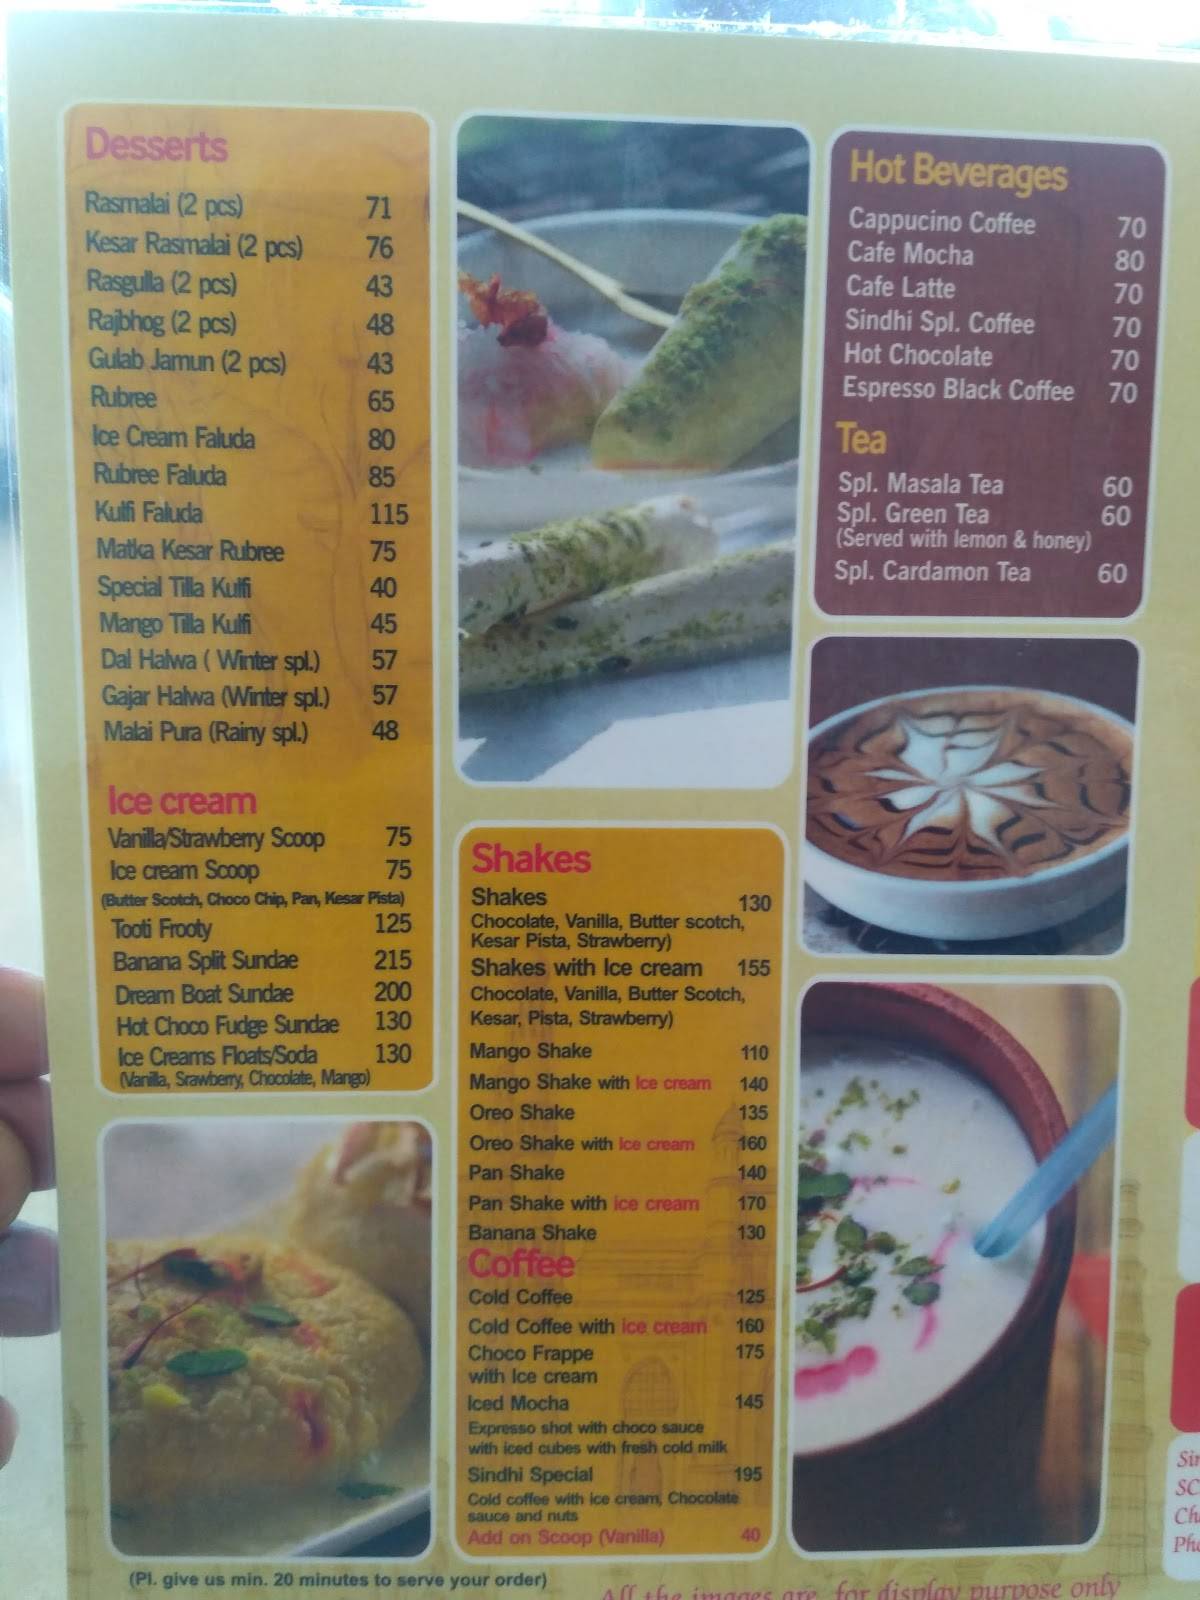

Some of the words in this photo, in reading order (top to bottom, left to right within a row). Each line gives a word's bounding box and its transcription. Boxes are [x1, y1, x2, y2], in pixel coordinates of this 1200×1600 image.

[86, 127, 228, 163] Desserts
[850, 150, 905, 184] Hot
[914, 152, 1068, 198] Beverages
[85, 191, 169, 213] Rasmalai
[178, 193, 197, 217] (2
[206, 194, 243, 220] pcs)
[367, 196, 391, 219] 71
[850, 207, 961, 235] Cappucino
[969, 212, 1036, 234] Coffee
[1118, 217, 1146, 238] 70
[848, 241, 895, 263] Cafe
[904, 242, 974, 265] Mocha
[1114, 250, 1144, 271] 80
[847, 275, 894, 296] Cafe
[902, 277, 956, 299] Latte
[1114, 284, 1143, 304] 70
[846, 308, 912, 331] Sindhi
[920, 311, 960, 336] Spl.
[968, 312, 1035, 334] Coffee
[1112, 317, 1141, 338] 70
[844, 343, 881, 364] Hot
[889, 343, 992, 366] Chocolate
[1110, 350, 1139, 370] 70
[91, 386, 157, 408] Rubree
[368, 391, 395, 412] 65
[843, 376, 935, 401] Espresso
[944, 377, 1001, 399] Black
[1009, 379, 1074, 401] Coffee
[1109, 383, 1137, 403] 70
[93, 425, 118, 447] Ice
[127, 425, 187, 447] Cream
[196, 427, 255, 449] Faluda
[368, 429, 395, 450] 80
[836, 421, 887, 454] Tea
[94, 462, 159, 484] Rubree
[167, 464, 226, 486] Faluda
[368, 466, 395, 487] 85
[839, 471, 877, 496] Spl.
[888, 473, 960, 493] Masala
[969, 474, 1004, 494] Tea
[1103, 476, 1132, 497] 60
[837, 502, 876, 527] Spl.
[886, 503, 946, 523] Green
[956, 503, 989, 524] Tea
[1101, 506, 1131, 525] 60
[97, 538, 153, 559] Matka
[162, 539, 212, 561] Kesar
[221, 540, 284, 561] Rubree
[370, 541, 396, 562] 75
[837, 528, 903, 548] (Served
[910, 529, 947, 547] with
[954, 530, 1007, 549] lemon
[1014, 532, 1026, 549] &
[1033, 531, 1092, 554] honey)
[835, 560, 873, 584] Spl.
[883, 560, 988, 581] Cardamon
[998, 562, 1031, 582] Tea
[1098, 564, 1127, 583] 60
[109, 785, 152, 815] Ice
[160, 793, 257, 815] cream
[472, 844, 591, 873] Shakes
[111, 860, 136, 880] Ice
[143, 864, 197, 879] cream
[205, 860, 260, 883] Scoop
[386, 860, 411, 879] 75
[472, 888, 547, 906] Shakes
[739, 895, 771, 912] 130
[112, 918, 151, 938] Tooti
[160, 918, 212, 942] Frooty
[375, 914, 411, 933] 125
[471, 914, 559, 931] Chocolate,
[565, 914, 622, 931] Vanilla,
[630, 914, 678, 929] Butter
[686, 914, 744, 931] scotch,
[472, 933, 517, 948] Kesar
[526, 933, 569, 950] Pista,
[577, 933, 671, 950] Strawberry)
[114, 952, 181, 971] Banana
[189, 951, 226, 975] Split
[233, 950, 298, 969] Sundae
[374, 950, 412, 970] 215
[472, 959, 545, 976] Shakes
[554, 959, 594, 976] with
[604, 959, 632, 976] Ice
[641, 963, 702, 976] cream
[738, 960, 770, 976] 155
[116, 985, 174, 1005] Dream
[182, 984, 221, 1004] Boat
[229, 983, 293, 1003] Sundae
[374, 981, 411, 1001] 200
[471, 1043, 530, 1062] Mango
[538, 1043, 592, 1057] Shake
[741, 1046, 768, 1061] 110
[470, 1074, 529, 1094] Mango
[538, 1074, 591, 1089] Shake
[598, 1076, 629, 1089] with
[636, 1076, 657, 1089] Ice
[664, 1079, 711, 1089] cream
[740, 1077, 768, 1091] 140
[470, 1105, 513, 1120] Oreo
[520, 1105, 575, 1120] Shake
[739, 1106, 768, 1120] 135
[470, 1136, 513, 1151] Oreo
[520, 1136, 574, 1150] Shake
[582, 1138, 612, 1150] with
[619, 1138, 640, 1150] Ice
[647, 1140, 694, 1150] cream
[739, 1136, 766, 1150] 160
[469, 1165, 502, 1180] Pan
[510, 1165, 564, 1180] Shake
[738, 1166, 766, 1180] 140
[469, 1226, 535, 1240] Banana
[543, 1226, 597, 1240] Shake
[738, 1226, 765, 1239] 130
[469, 1249, 575, 1277] Coffee
[469, 1290, 509, 1304] Cold
[516, 1290, 572, 1304] Coffee
[737, 1290, 765, 1303] 125
[469, 1346, 525, 1361] Choco
[534, 1346, 593, 1363] Frappe
[736, 1345, 764, 1359] 175
[468, 1396, 503, 1411] Iced
[512, 1396, 569, 1411] Mocha
[736, 1395, 763, 1409] 145
[469, 1422, 535, 1437] Expresso
[541, 1422, 572, 1434] shot
[579, 1422, 606, 1433] with
[613, 1422, 656, 1433] choco
[662, 1424, 704, 1433] sauce
[468, 1467, 523, 1482] Sindhi
[531, 1467, 592, 1485] Special
[735, 1467, 762, 1481] 195
[468, 1513, 509, 1522] sauce
[516, 1511, 542, 1522] and
[548, 1511, 578, 1522] nuts
[468, 1530, 502, 1545] Add
[510, 1533, 531, 1545] on
[539, 1530, 592, 1548] Scoop
[600, 1529, 664, 1546] (Vanilla)
[741, 1529, 760, 1542] 40
[129, 1571, 157, 1588] (Pl.
[162, 1572, 198, 1589] give
[205, 1576, 224, 1586] us
[231, 1572, 268, 1586] min.
[273, 1573, 293, 1586] 20
[300, 1573, 369, 1586] minutes
[374, 1574, 391, 1586] to
[398, 1576, 444, 1587] serve
[450, 1576, 488, 1590] your
[495, 1573, 546, 1590] order)
